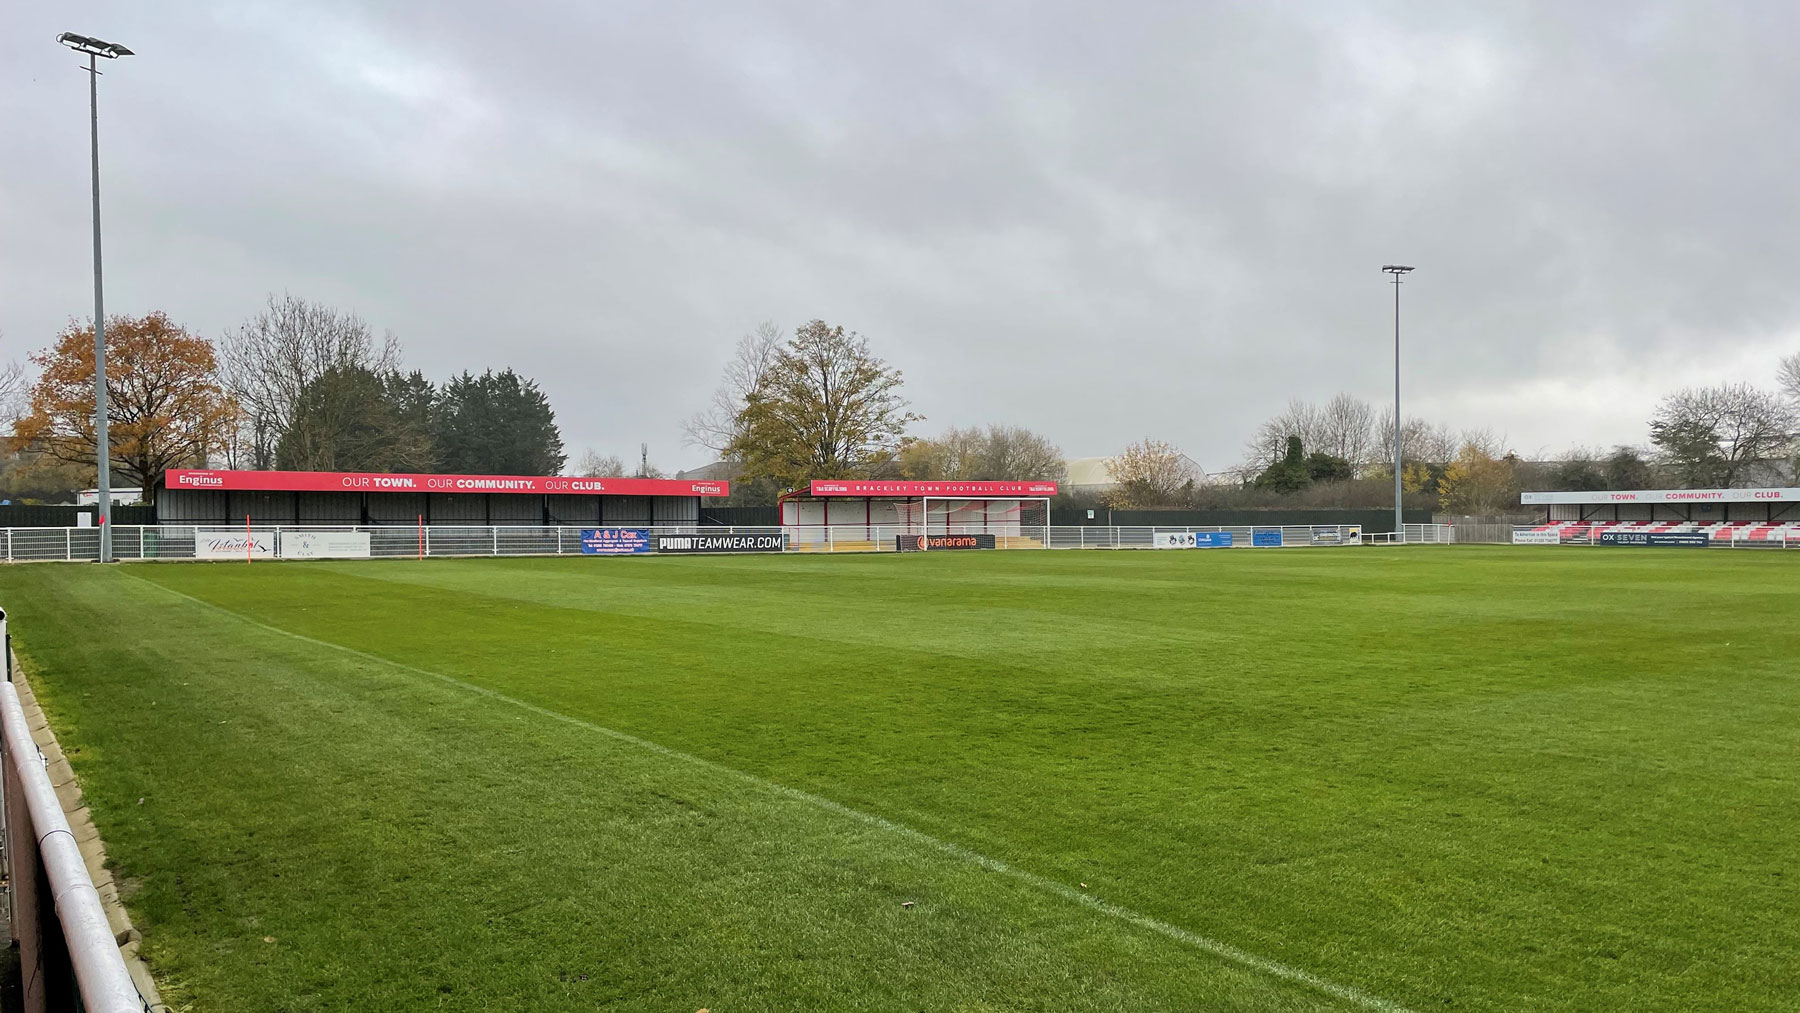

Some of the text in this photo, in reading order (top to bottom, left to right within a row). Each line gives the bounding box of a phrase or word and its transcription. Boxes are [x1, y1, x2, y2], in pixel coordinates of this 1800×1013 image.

[180, 475, 223, 486] Enginus
[342, 477, 604, 490] OUR TOWN. OUR COMMUNITY. OUR CLUB.
[692, 484, 720, 493] Enginus
[594, 530, 637, 538] A & J Cox
[930, 537, 976, 546] vanarama
